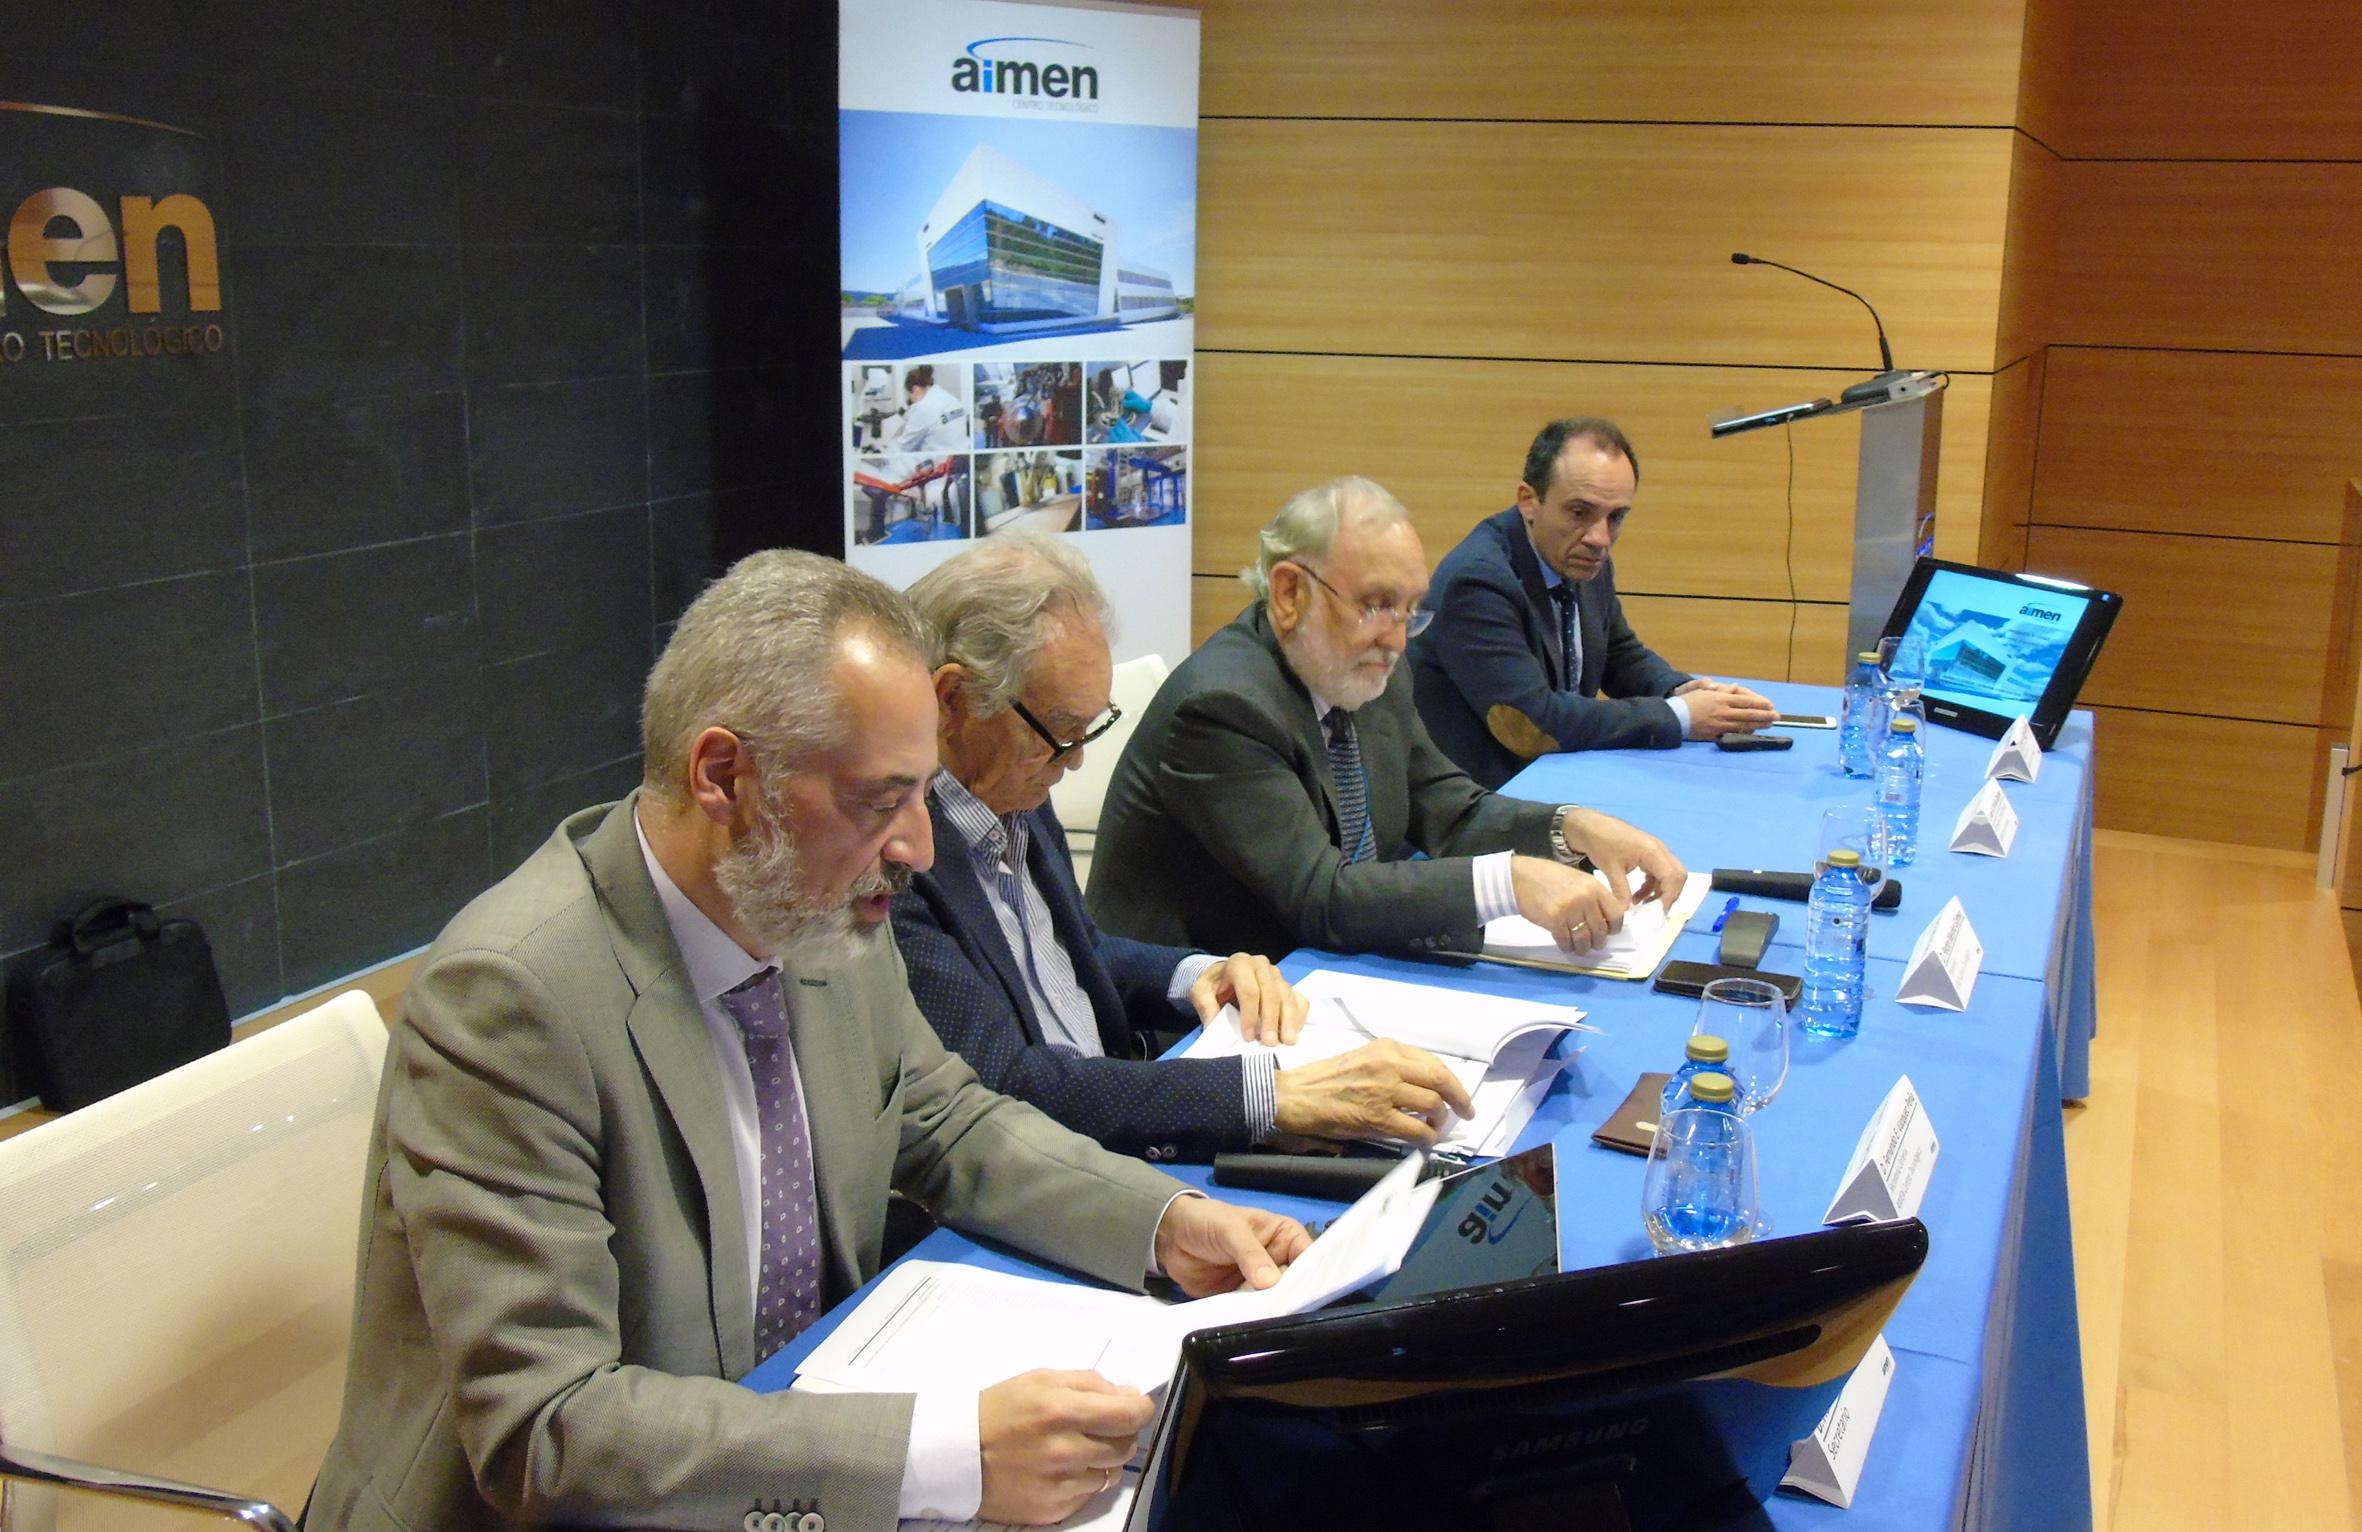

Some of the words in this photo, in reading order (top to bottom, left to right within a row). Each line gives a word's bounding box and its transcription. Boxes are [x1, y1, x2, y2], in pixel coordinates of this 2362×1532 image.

[951, 57, 1099, 99] aimen
[0, 187, 222, 316] en
[1491, 1417, 1649, 1461] SAMSUNG
[1828, 1407, 1850, 1460] Secretario
